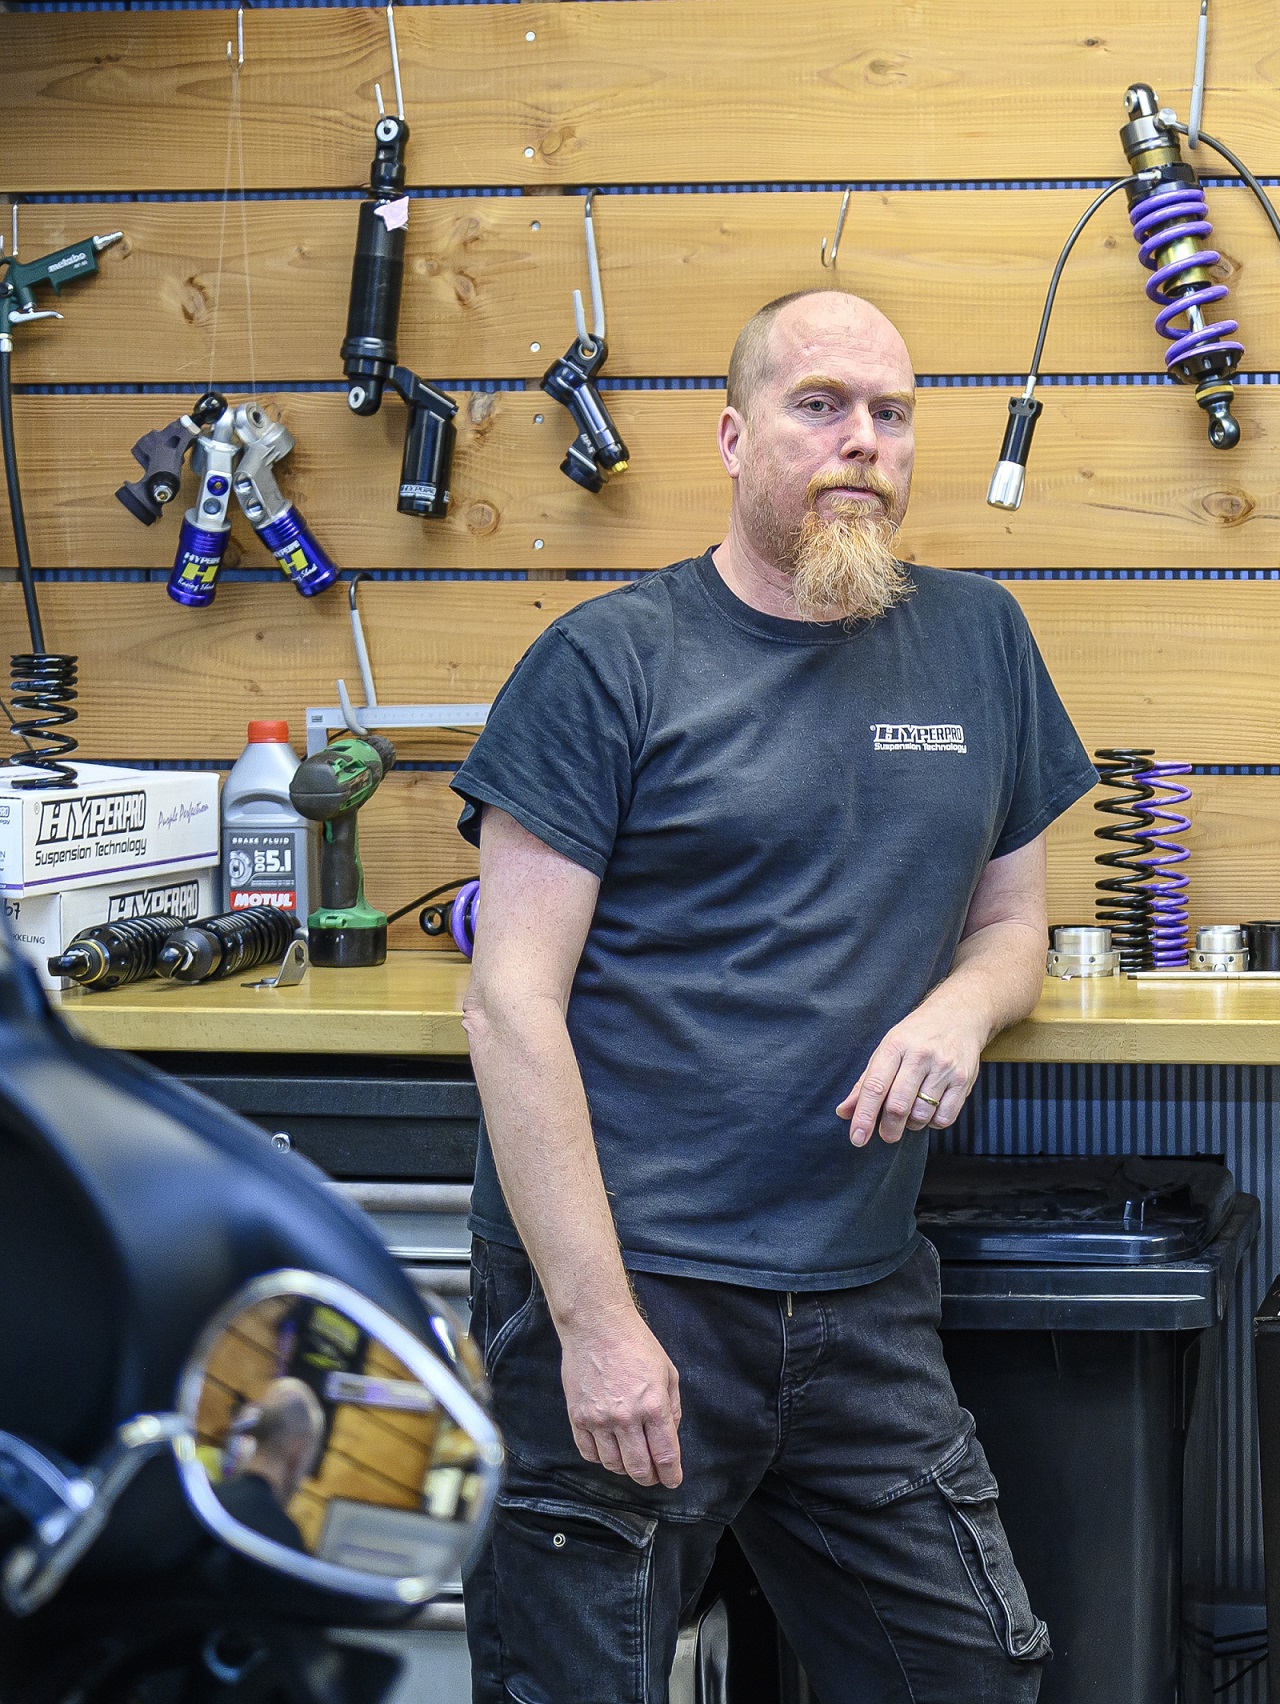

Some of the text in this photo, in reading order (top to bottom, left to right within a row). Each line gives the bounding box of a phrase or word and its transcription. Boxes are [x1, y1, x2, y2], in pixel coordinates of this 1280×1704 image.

[47, 252, 87, 273] metabo
[874, 724, 964, 744] HYPERPRO
[874, 742, 968, 754] Suspension Technology
[36, 790, 146, 845] HYPERPRO
[232, 837, 290, 845] BRAKE FLUID
[35, 837, 147, 867] Suspension Technology
[254, 849, 292, 872] DOT 5.1
[233, 893, 293, 908] MOTUL
